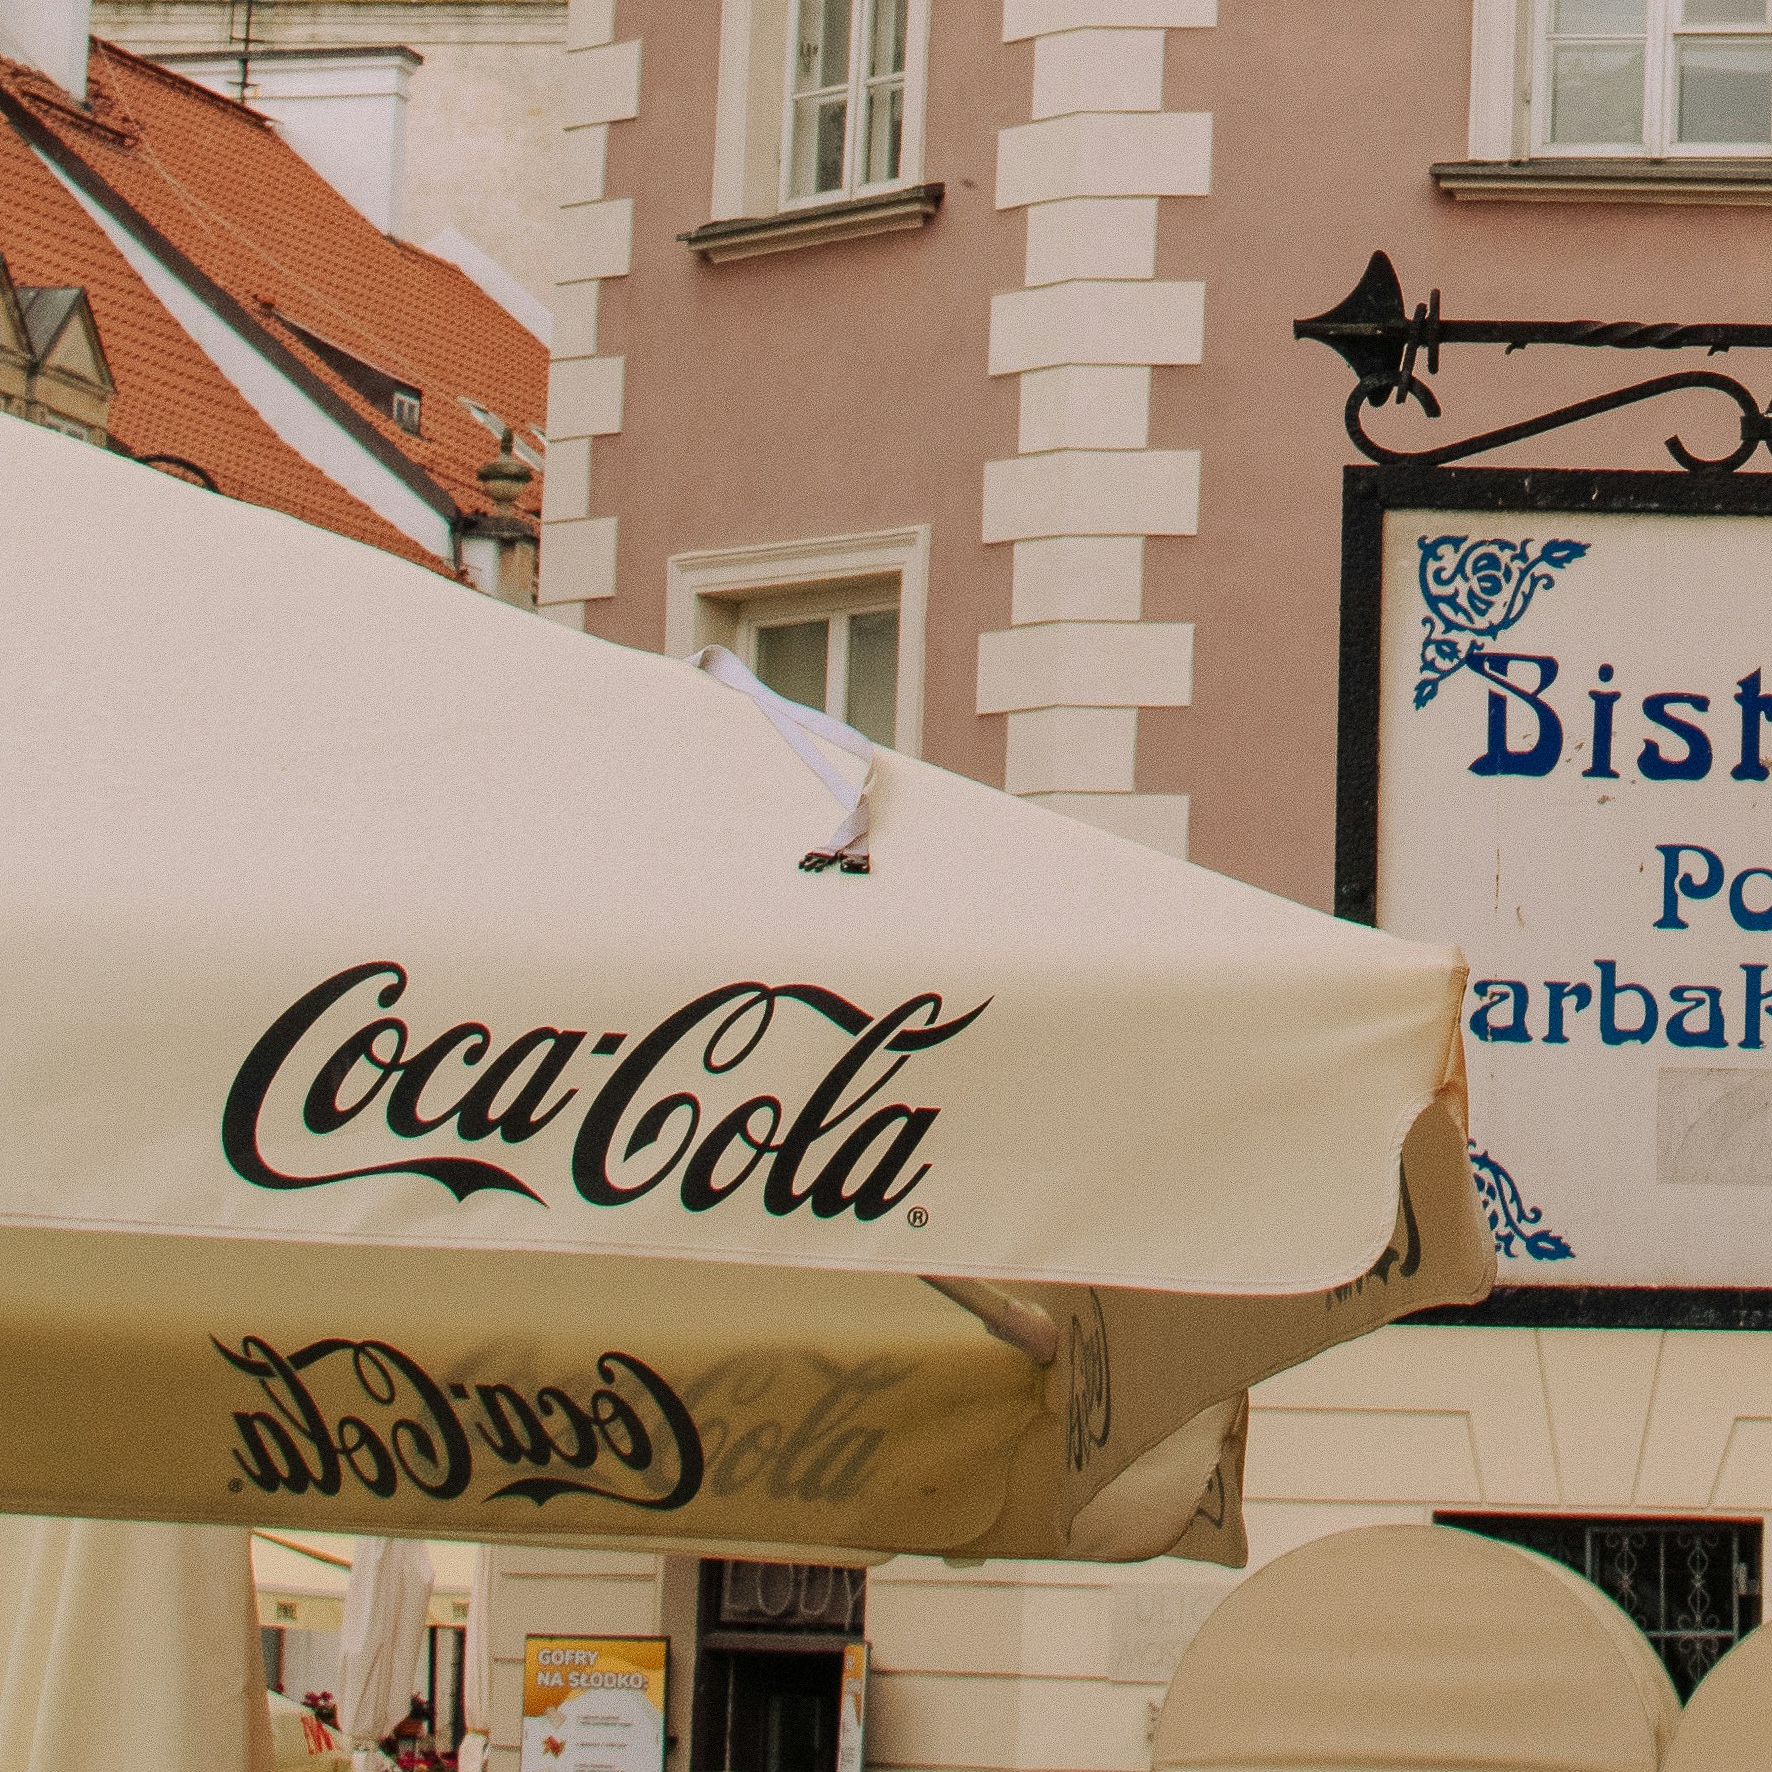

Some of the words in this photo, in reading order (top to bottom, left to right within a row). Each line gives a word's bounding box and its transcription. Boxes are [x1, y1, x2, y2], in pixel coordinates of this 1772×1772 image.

[222, 961, 994, 1221] Coca-Cola
[538, 1648, 598, 1667] GOFRY
[537, 1670, 563, 1687] NA
